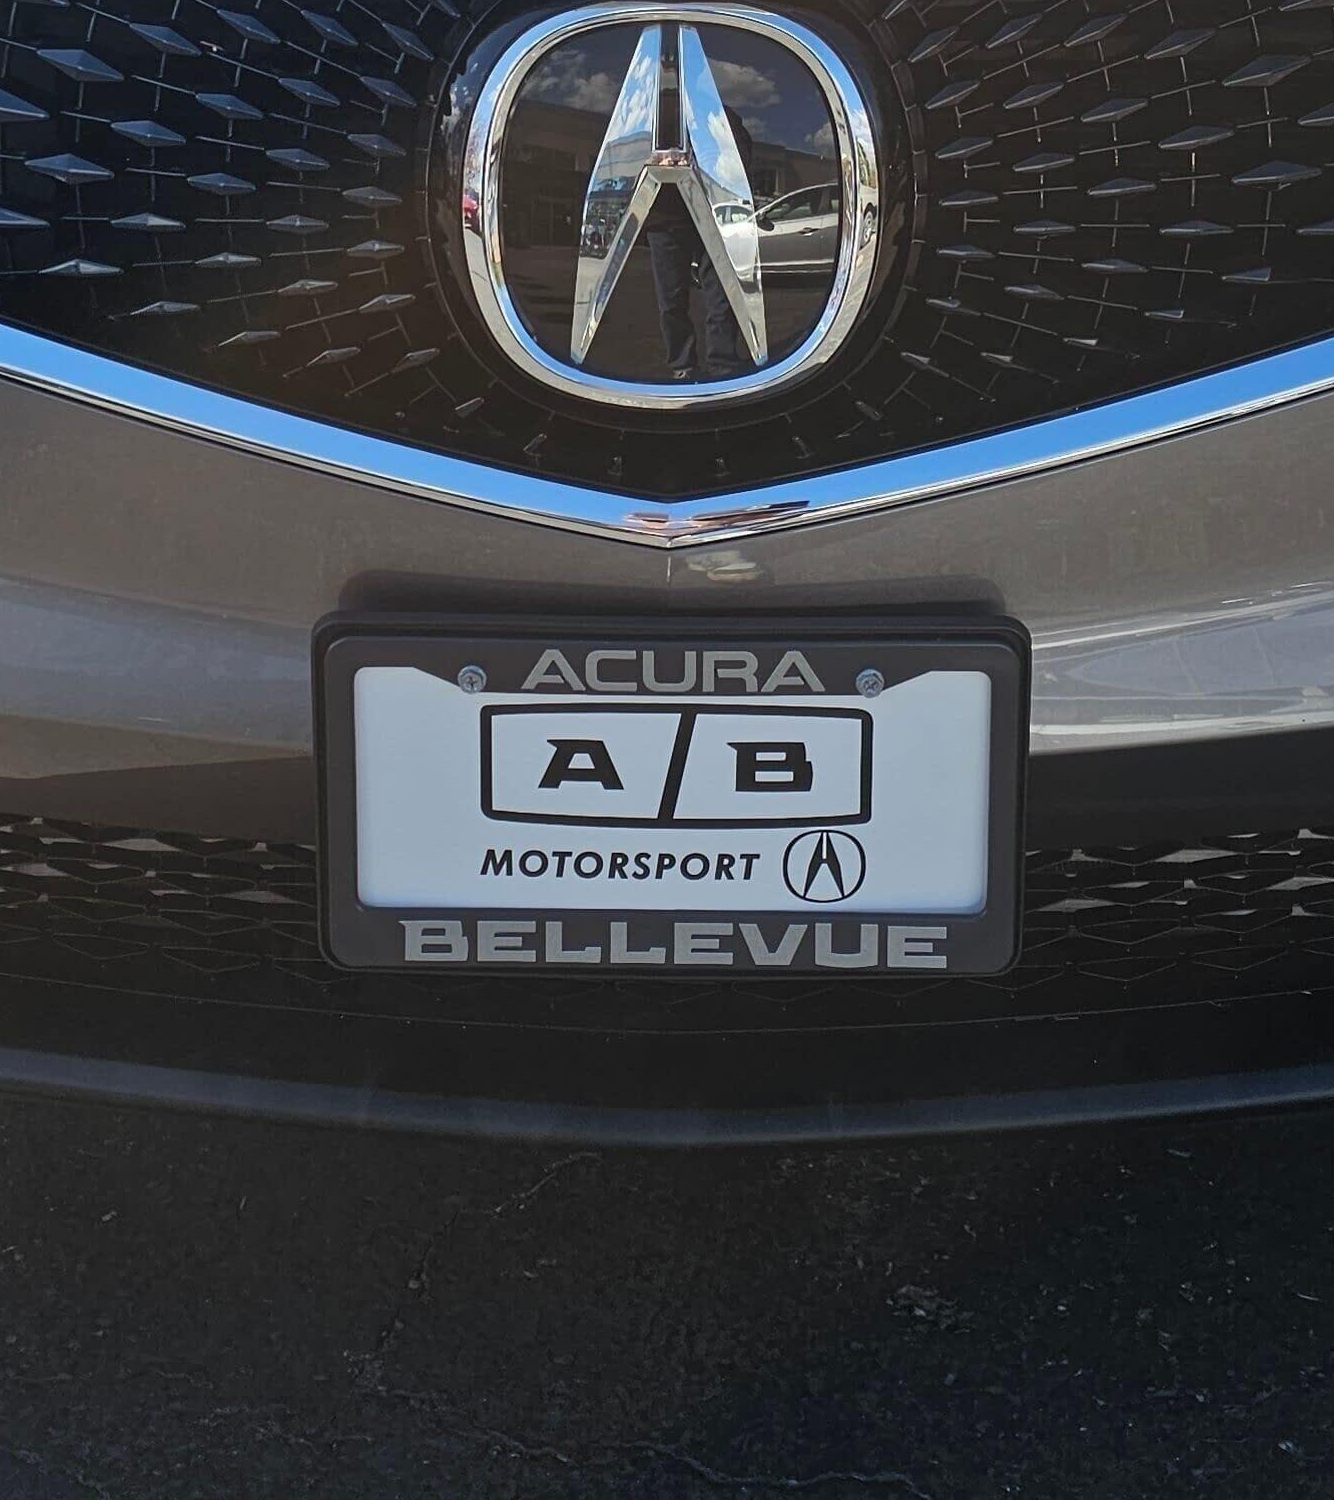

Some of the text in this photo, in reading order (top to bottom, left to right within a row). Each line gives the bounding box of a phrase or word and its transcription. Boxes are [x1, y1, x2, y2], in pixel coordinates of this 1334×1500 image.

[520, 648, 826, 694] ACURA
[537, 739, 814, 793] A B
[480, 848, 761, 882] MOTORSPORT
[398, 919, 948, 969] BELLEVUE
